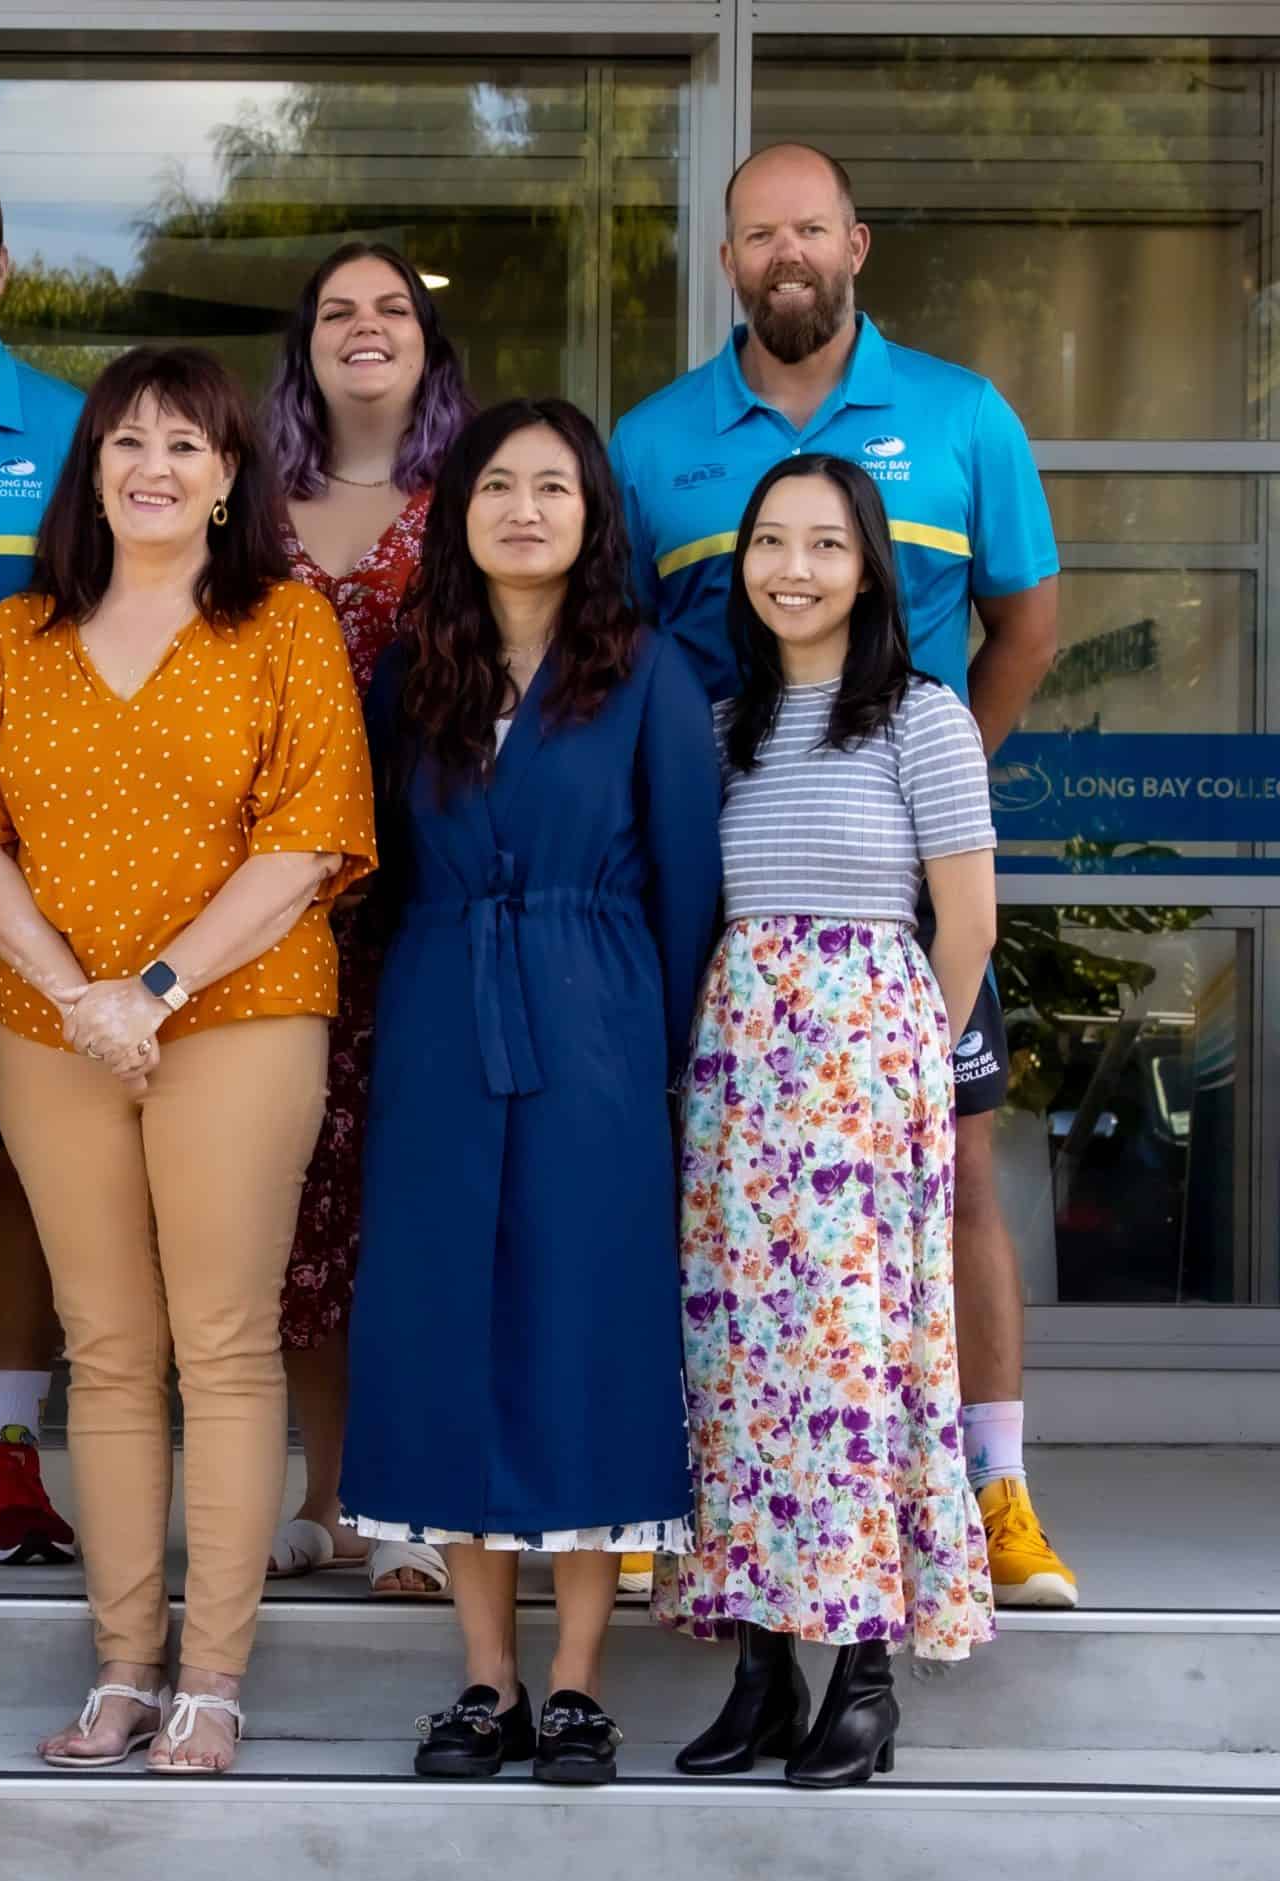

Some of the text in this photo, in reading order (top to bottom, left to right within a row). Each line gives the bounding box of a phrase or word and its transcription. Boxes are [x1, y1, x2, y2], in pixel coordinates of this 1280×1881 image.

[889, 461, 911, 470] BAY
[867, 471, 910, 481] LLEGE
[23, 480, 43, 489] BAY
[1063, 776, 1280, 799] LONG BAY COLLE
[953, 1060, 1001, 1084] COLLEGE
